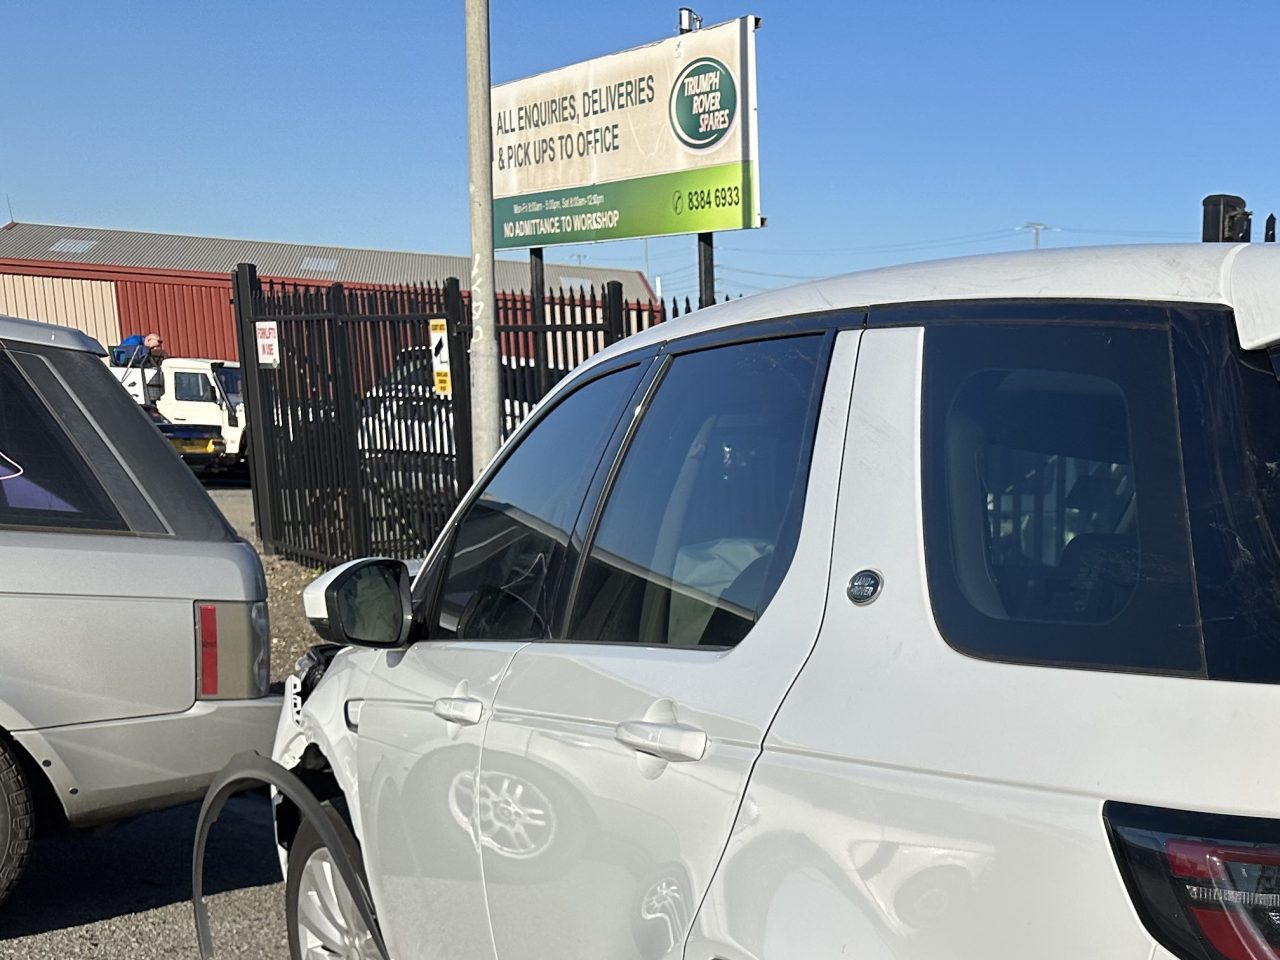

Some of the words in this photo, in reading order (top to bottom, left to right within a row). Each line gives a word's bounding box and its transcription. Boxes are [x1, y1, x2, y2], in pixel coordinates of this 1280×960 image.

[684, 70, 720, 96] TRIUMPH
[496, 109, 515, 136] ALL
[518, 94, 580, 131] ENQUIRIES,
[583, 74, 655, 118] DELIVERIES
[692, 91, 721, 115] ROVER
[699, 108, 730, 133] SPARES
[498, 147, 505, 171] &
[507, 141, 531, 169] PICK
[534, 137, 555, 165] UPS
[558, 133, 574, 160] TO
[577, 124, 619, 157] OFFICE
[688, 188, 712, 211] 8384
[714, 185, 740, 208] 6933
[504, 221, 514, 238] NO
[515, 217, 560, 237] ADMITTANCE
[561, 215, 572, 232] TO
[573, 210, 619, 231] WORKSHOP
